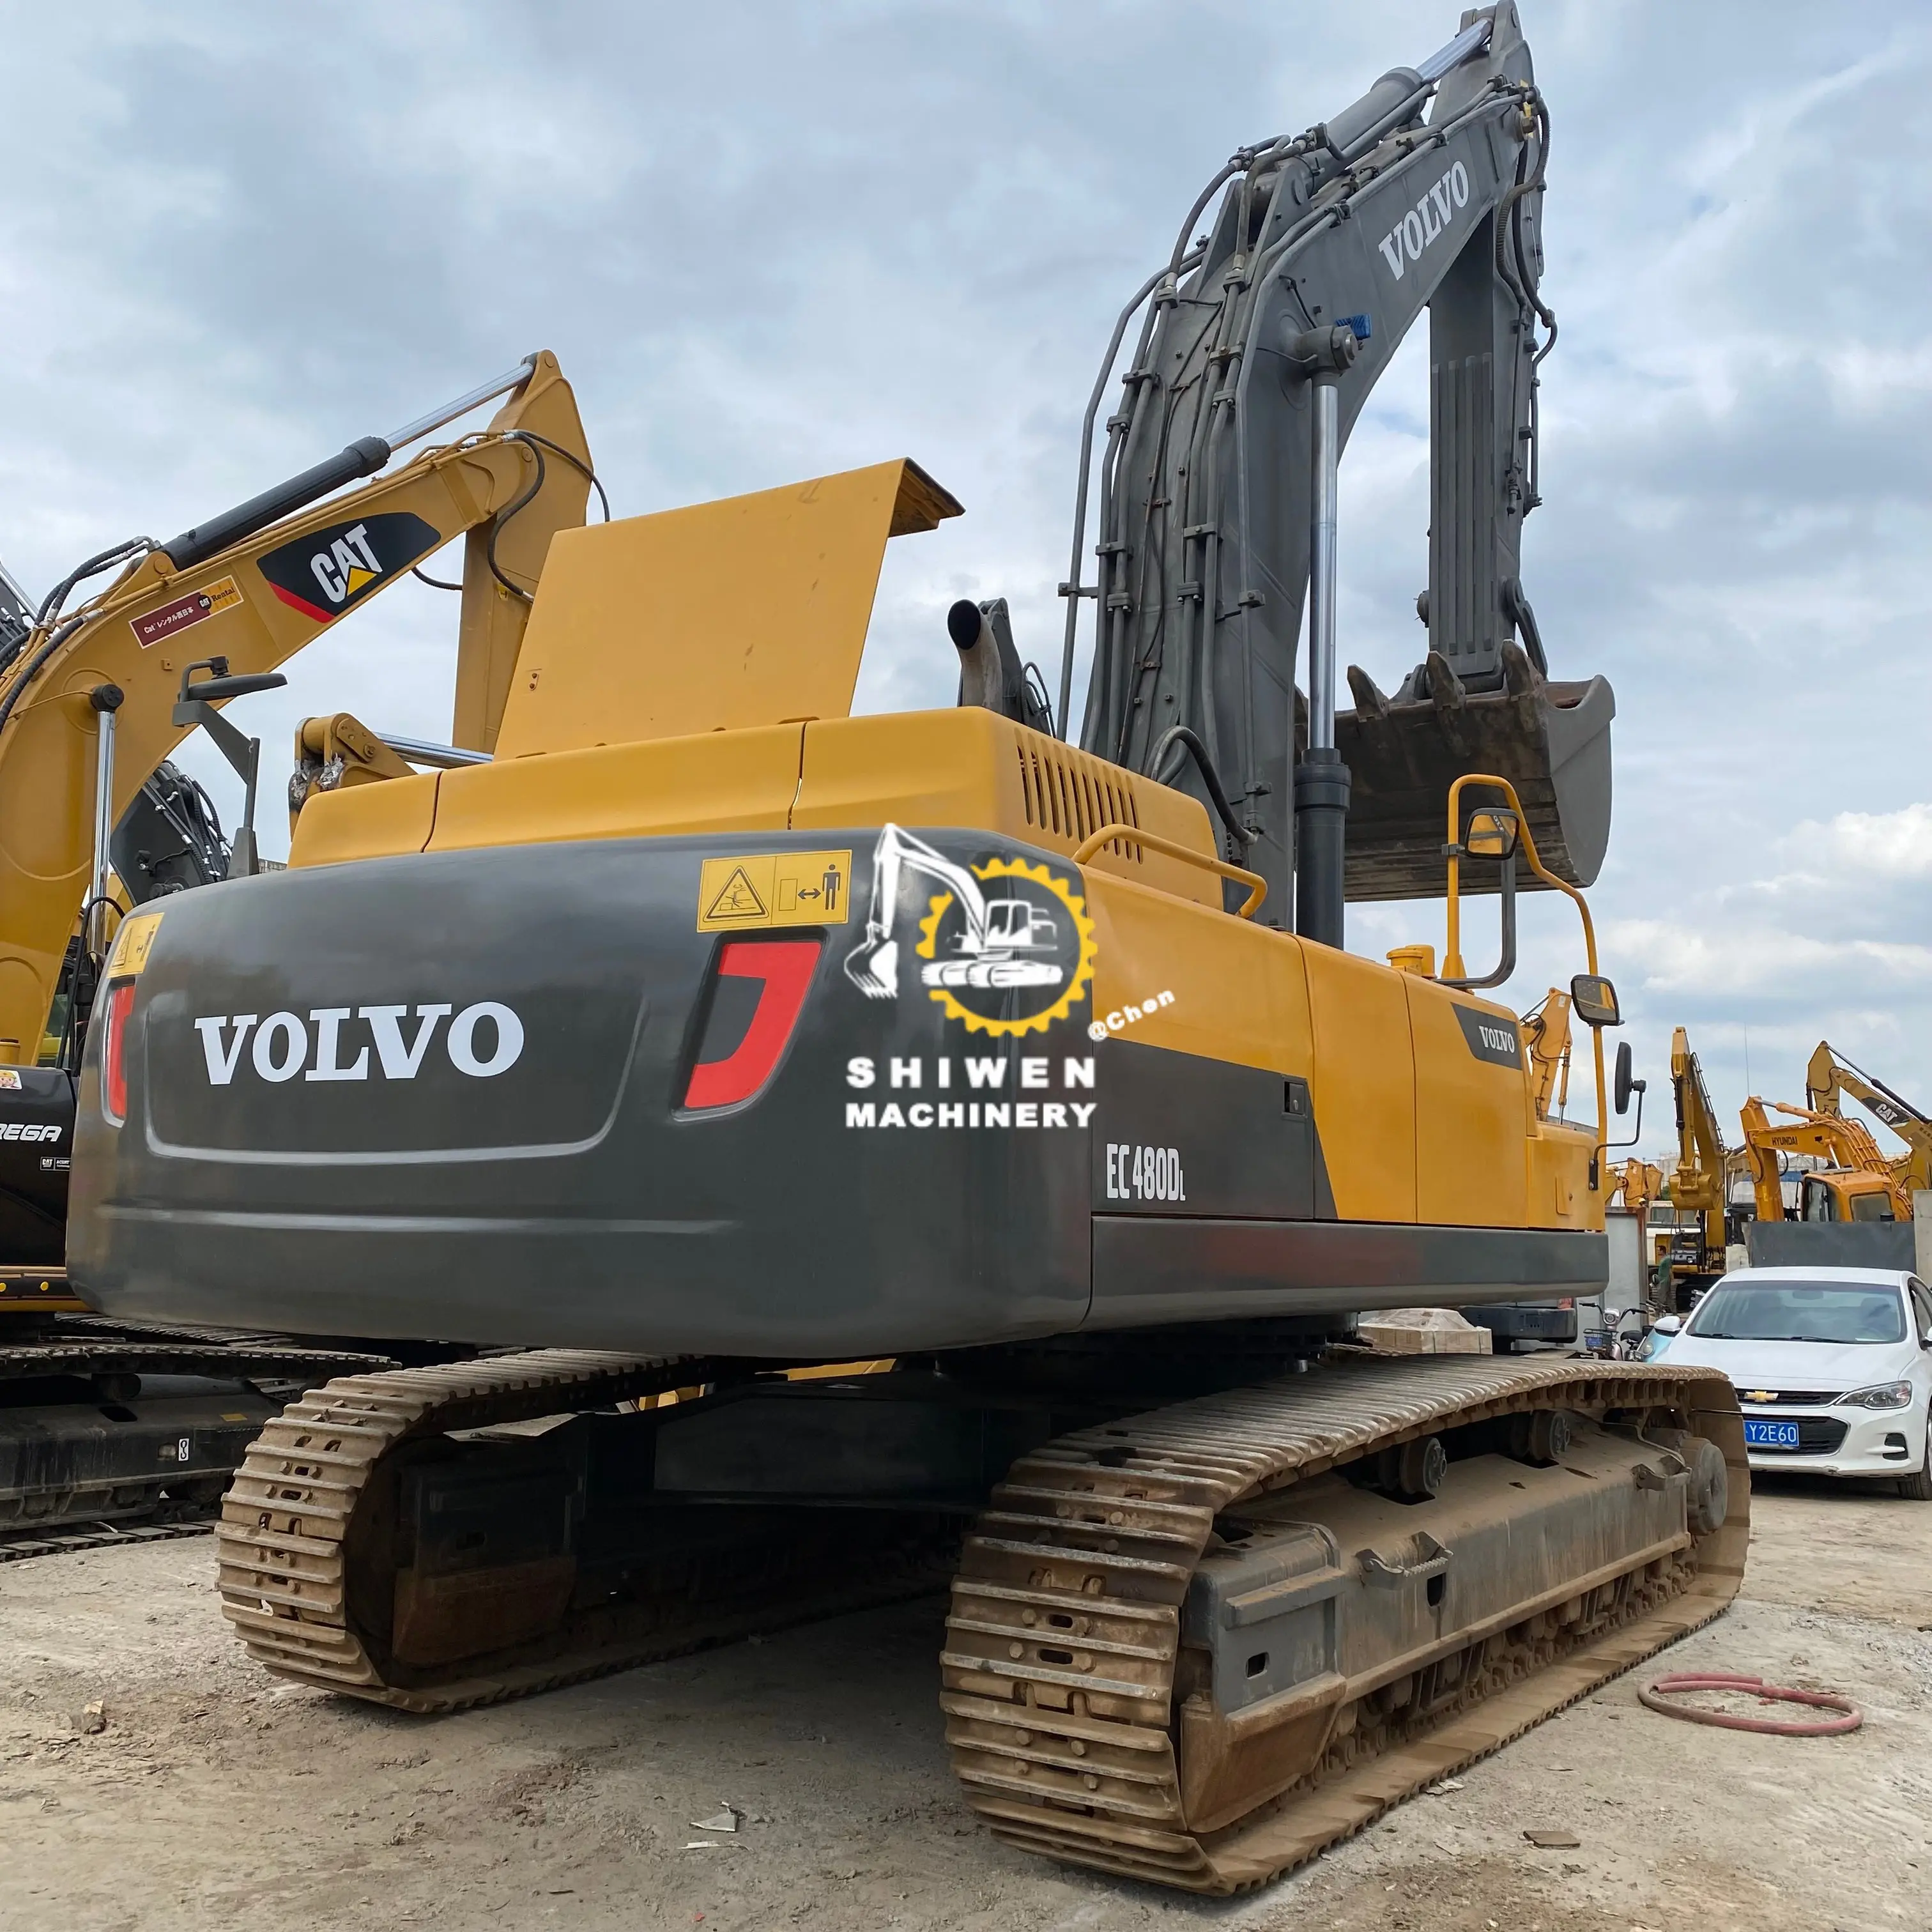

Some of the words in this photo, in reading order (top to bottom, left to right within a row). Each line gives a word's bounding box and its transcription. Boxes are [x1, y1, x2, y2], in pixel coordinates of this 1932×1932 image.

[1378, 160, 1469, 280] VOLVO
[310, 523, 383, 602] CAT
[211, 587, 235, 601] Rental
[157, 607, 194, 627] レンタル西日本
[194, 1001, 524, 1085] VOLVO
[1478, 1025, 1515, 1054] VOLVO
[1876, 1103, 1898, 1123] CAT
[1771, 1135, 1798, 1146] HYUNDAI
